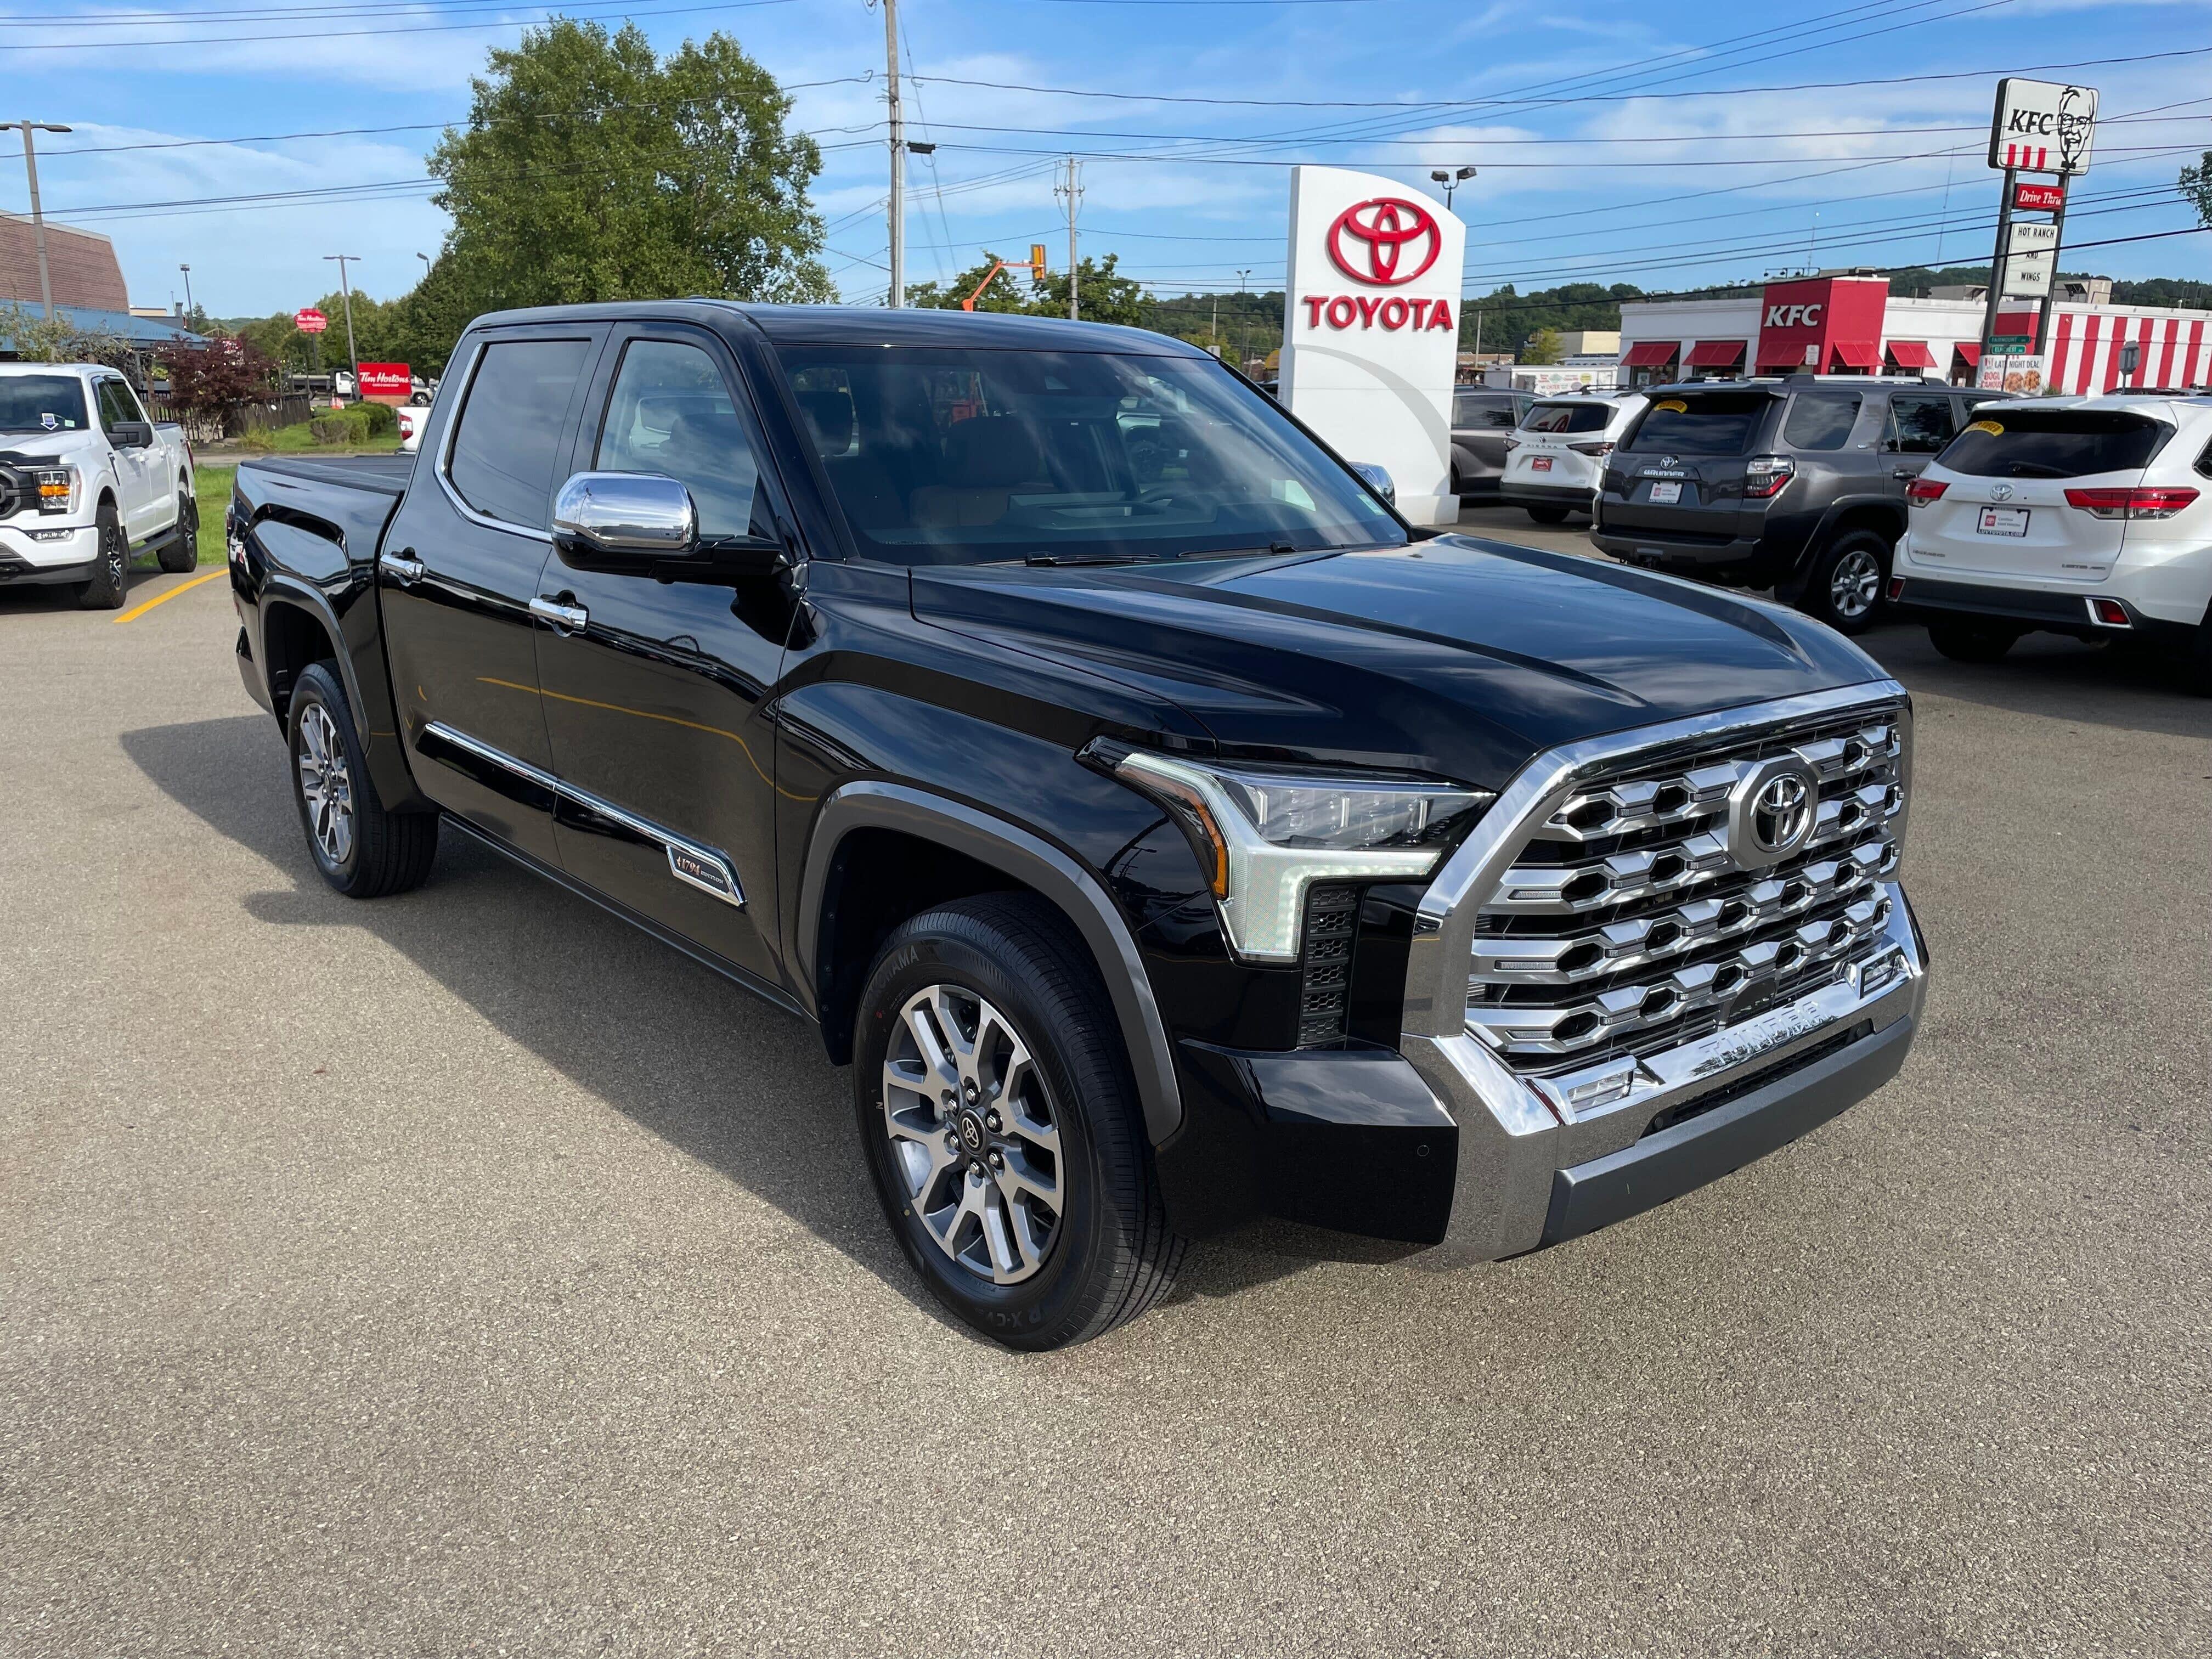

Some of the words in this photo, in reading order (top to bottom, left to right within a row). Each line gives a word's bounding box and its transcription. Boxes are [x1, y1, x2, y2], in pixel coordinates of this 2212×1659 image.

[2008, 109, 2054, 135] KFC
[2019, 190, 2041, 203] Drive
[2018, 227, 2030, 236] HOT
[2033, 228, 2055, 238] RANCH
[2021, 272, 2040, 281] WINGS
[1304, 295, 1453, 330] TOYOTA
[1764, 304, 1822, 327] KFC
[359, 372, 376, 383] Tim
[377, 372, 409, 383] Hortons
[701, 870, 724, 884] EDITION
[1699, 1001, 1830, 1066] TUNDRA
